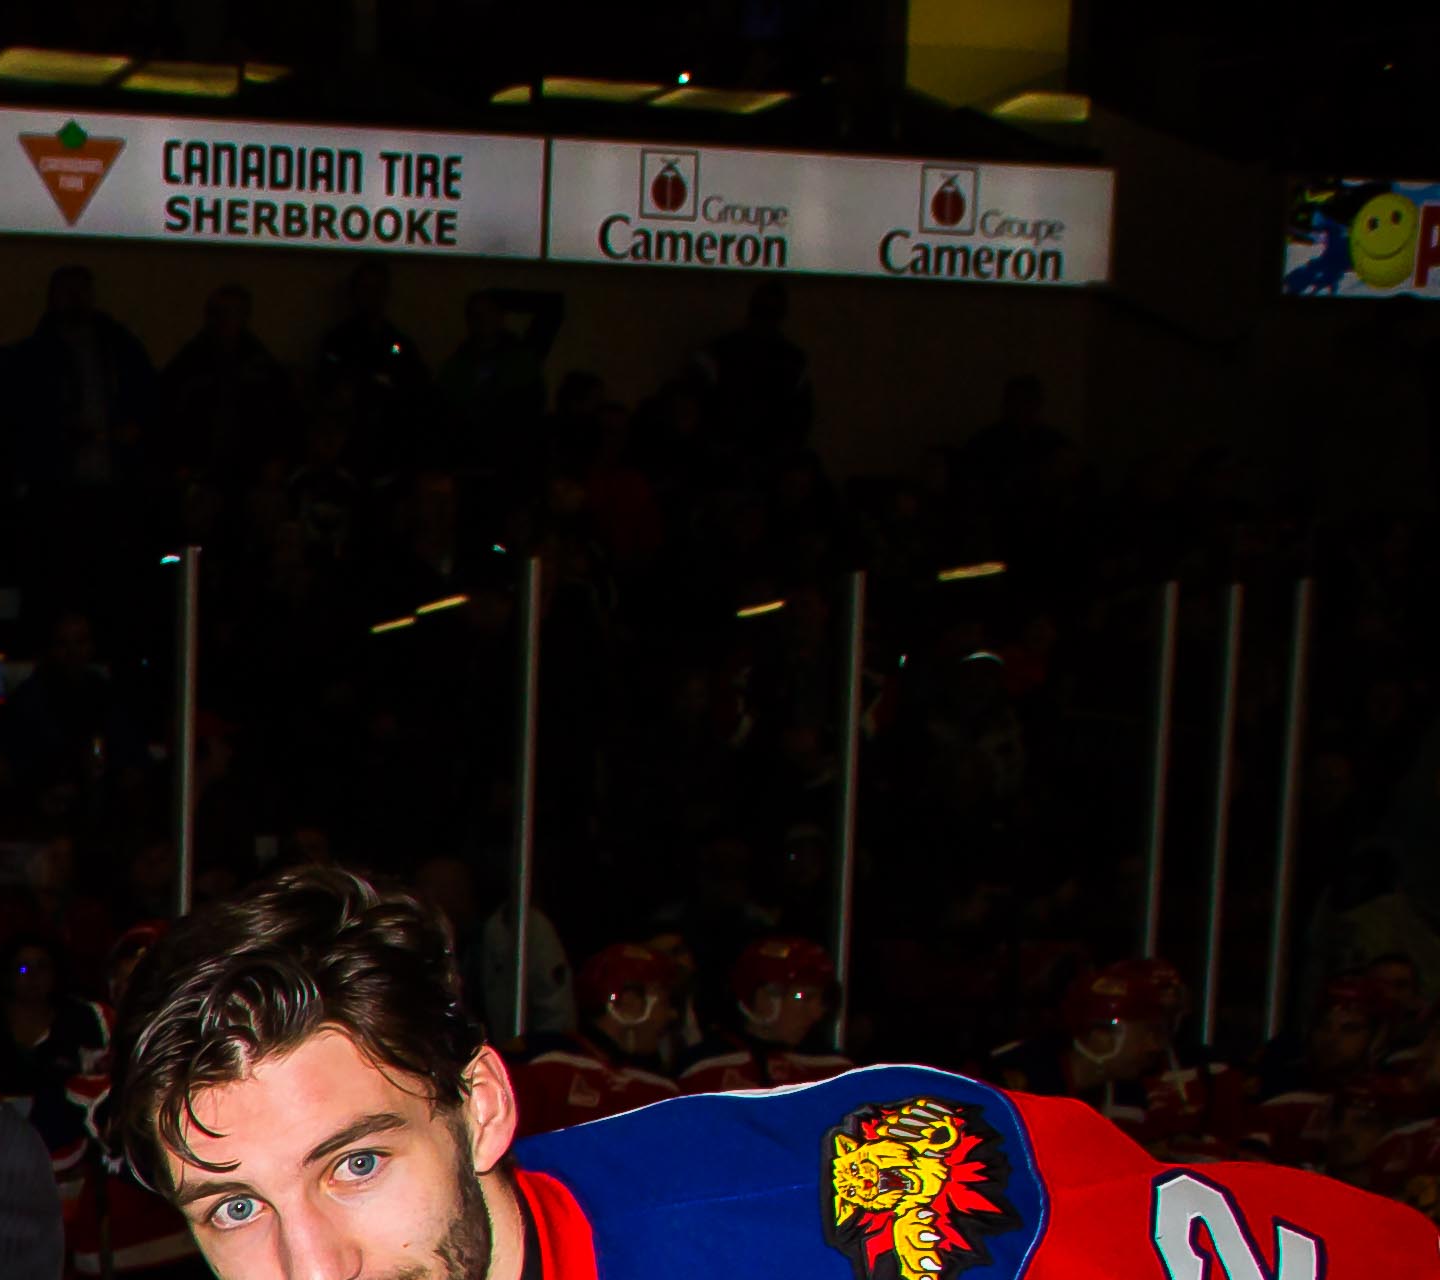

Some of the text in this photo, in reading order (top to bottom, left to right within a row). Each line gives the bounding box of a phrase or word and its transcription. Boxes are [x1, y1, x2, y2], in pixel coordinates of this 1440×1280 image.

[163, 140, 363, 194] CANADIAN
[380, 152, 463, 200] TIRE
[164, 197, 457, 245] SHERBROOKE
[701, 197, 789, 227] Groupe
[979, 212, 1064, 242] Groupe
[599, 215, 788, 268] Cameron
[880, 230, 1062, 283] Cameron
